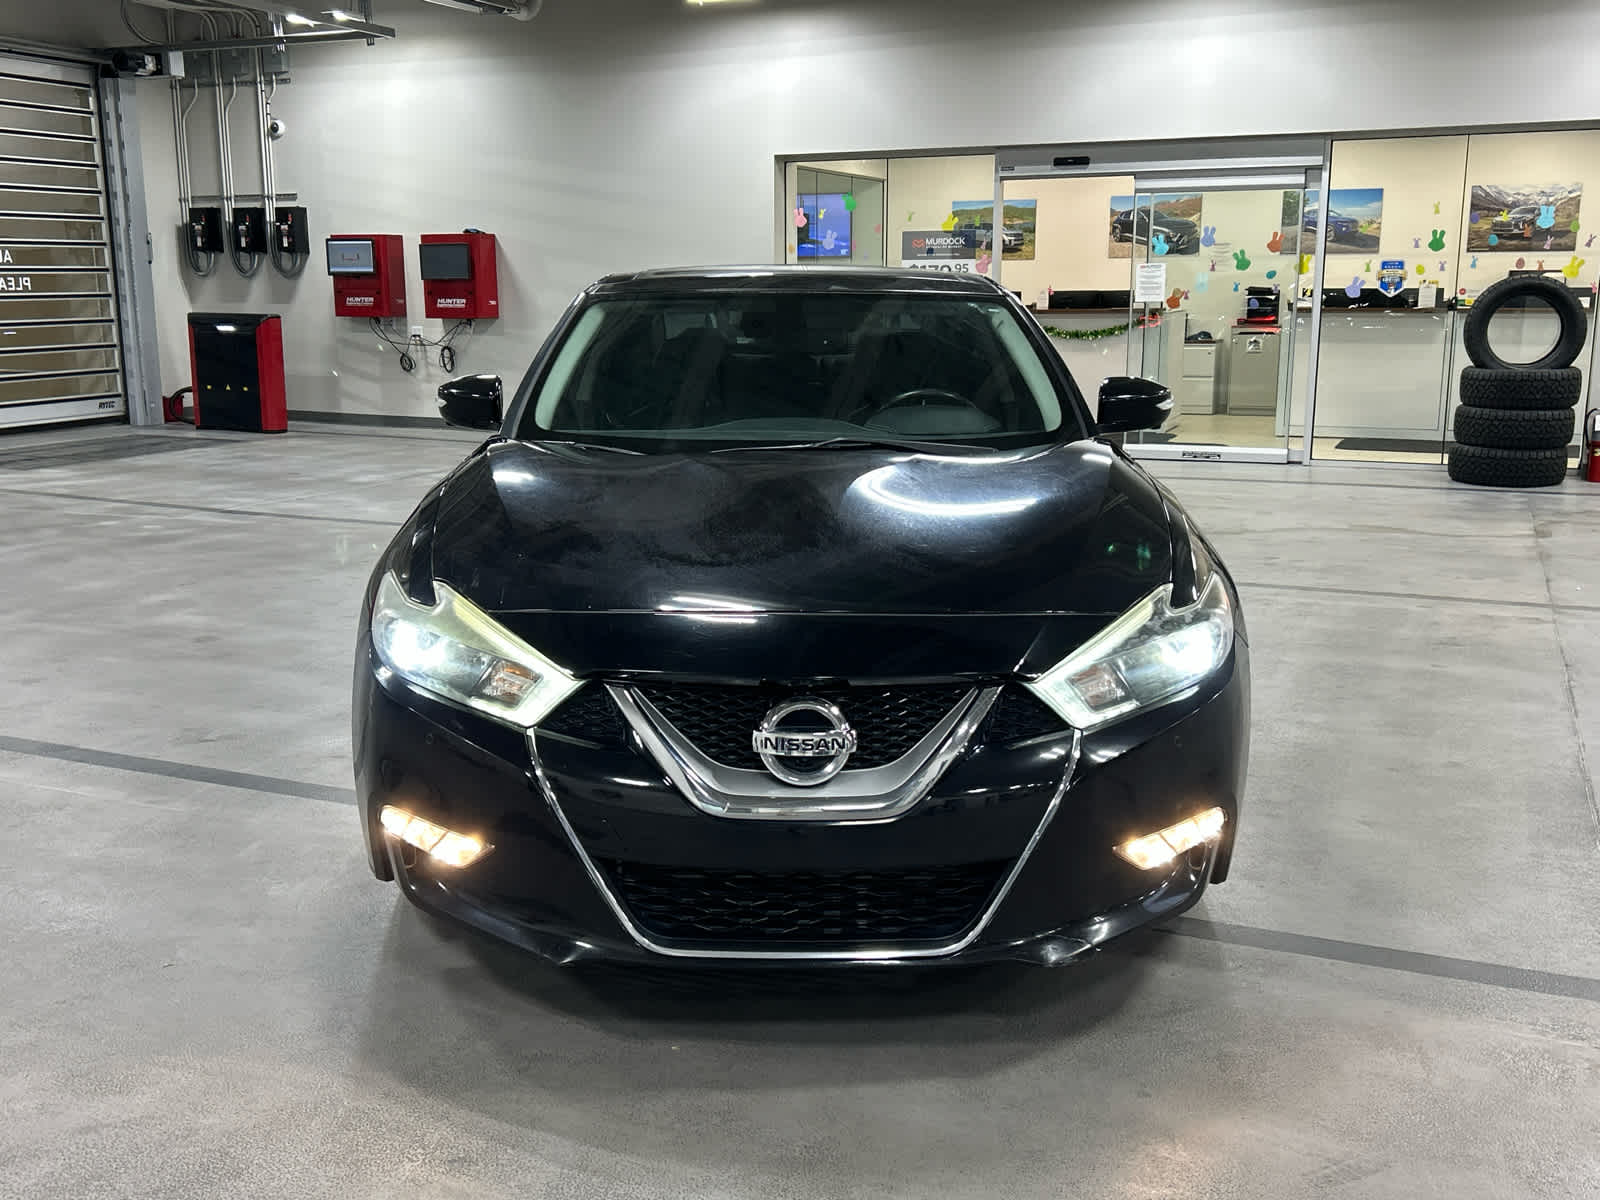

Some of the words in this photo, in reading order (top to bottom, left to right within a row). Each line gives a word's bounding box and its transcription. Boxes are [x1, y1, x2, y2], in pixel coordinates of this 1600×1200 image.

[926, 237, 965, 245] MURDOCK
[346, 296, 374, 304] HUNTER
[764, 737, 846, 751] NISSAN
